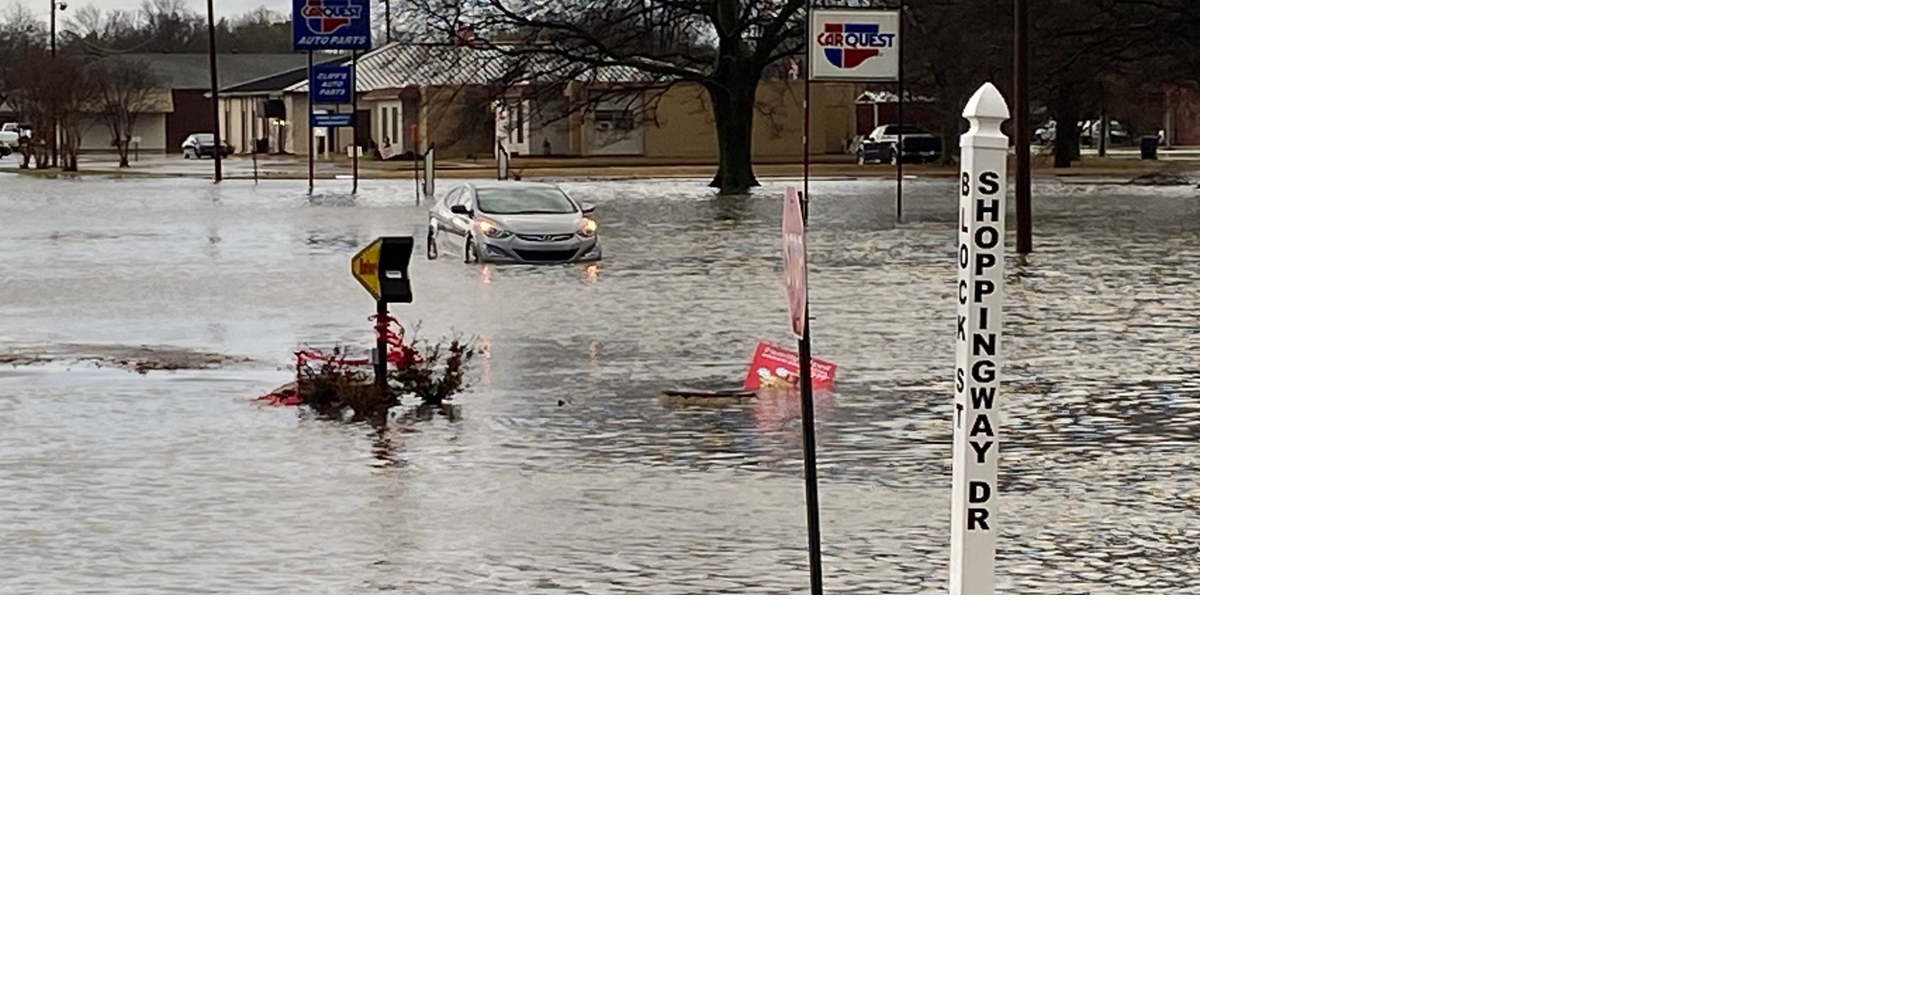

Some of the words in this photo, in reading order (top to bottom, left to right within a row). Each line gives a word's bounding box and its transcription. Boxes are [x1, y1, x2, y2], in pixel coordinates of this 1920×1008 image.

[298, 36, 329, 45] AUTO
[330, 36, 366, 45] PARTS
[817, 32, 895, 48] CARQUEST
[957, 172, 970, 342] BLOCK
[969, 172, 1000, 463] SHOPPINGWAY
[956, 368, 965, 429] ST
[967, 481, 991, 530] DR
